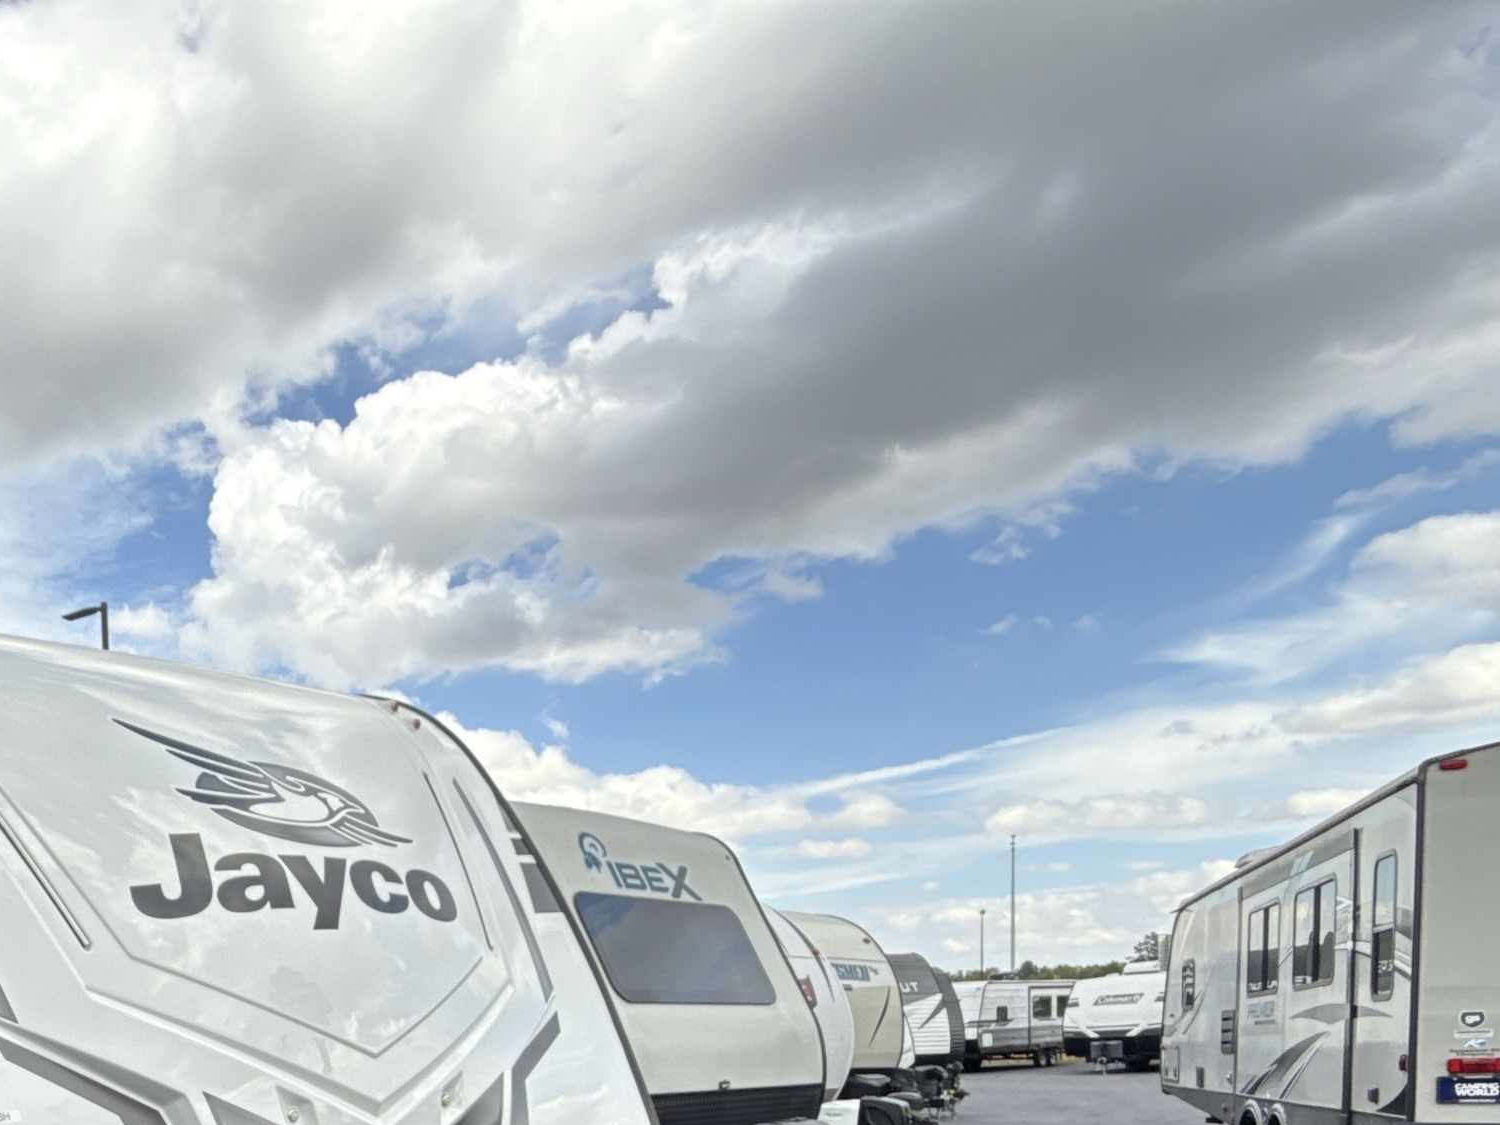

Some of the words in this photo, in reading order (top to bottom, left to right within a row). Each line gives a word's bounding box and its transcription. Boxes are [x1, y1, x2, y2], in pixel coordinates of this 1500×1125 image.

[130, 832, 458, 930] Jayco
[605, 860, 703, 901] IBEX
[1455, 1088, 1500, 1097] WORLD
